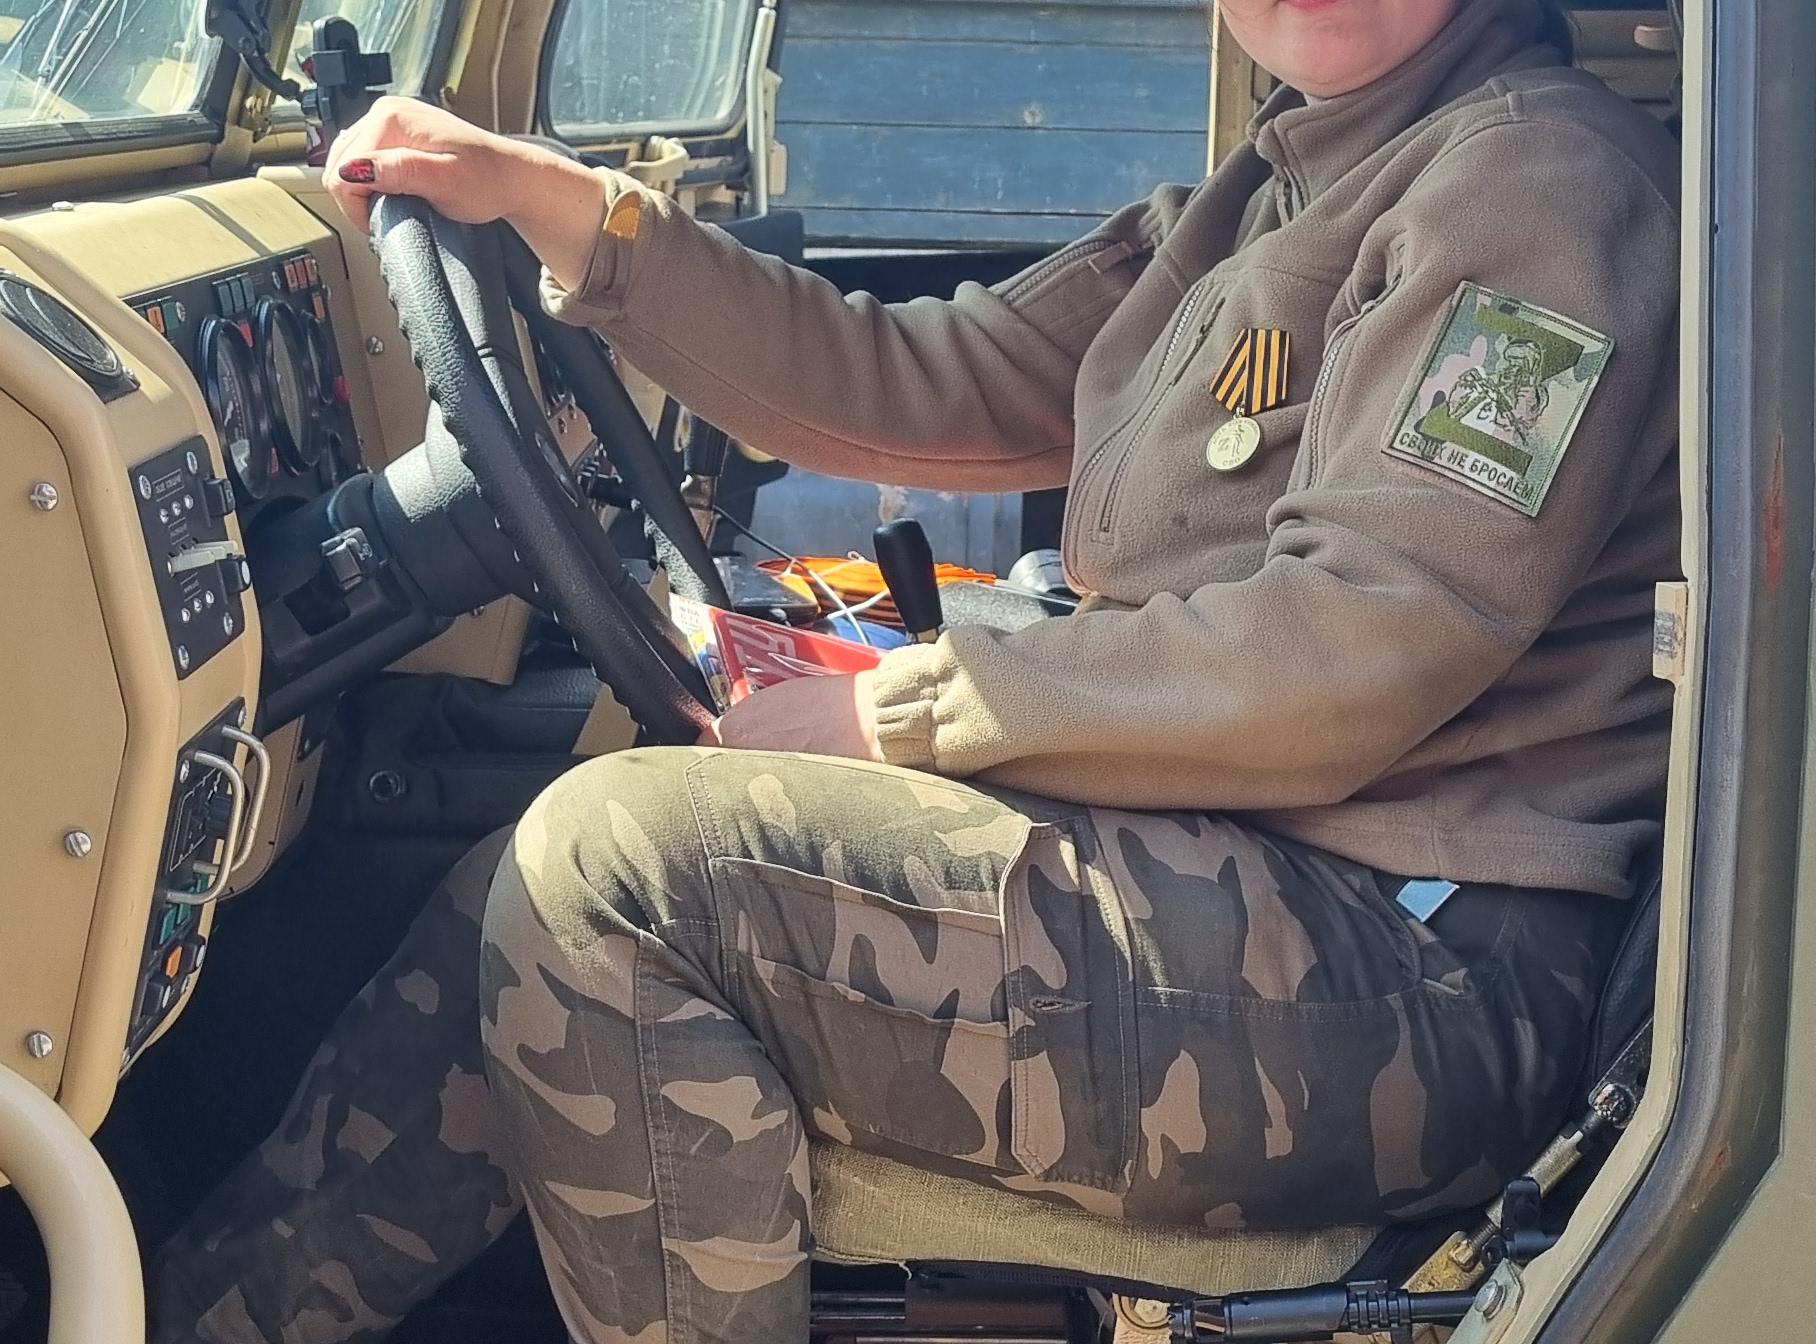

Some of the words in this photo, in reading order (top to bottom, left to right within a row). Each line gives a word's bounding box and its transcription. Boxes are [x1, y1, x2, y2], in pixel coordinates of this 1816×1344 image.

[1399, 432, 1446, 462] СВОИХ
[1447, 448, 1469, 470] НЕ
[1469, 458, 1537, 502] БРОСАЕМ
